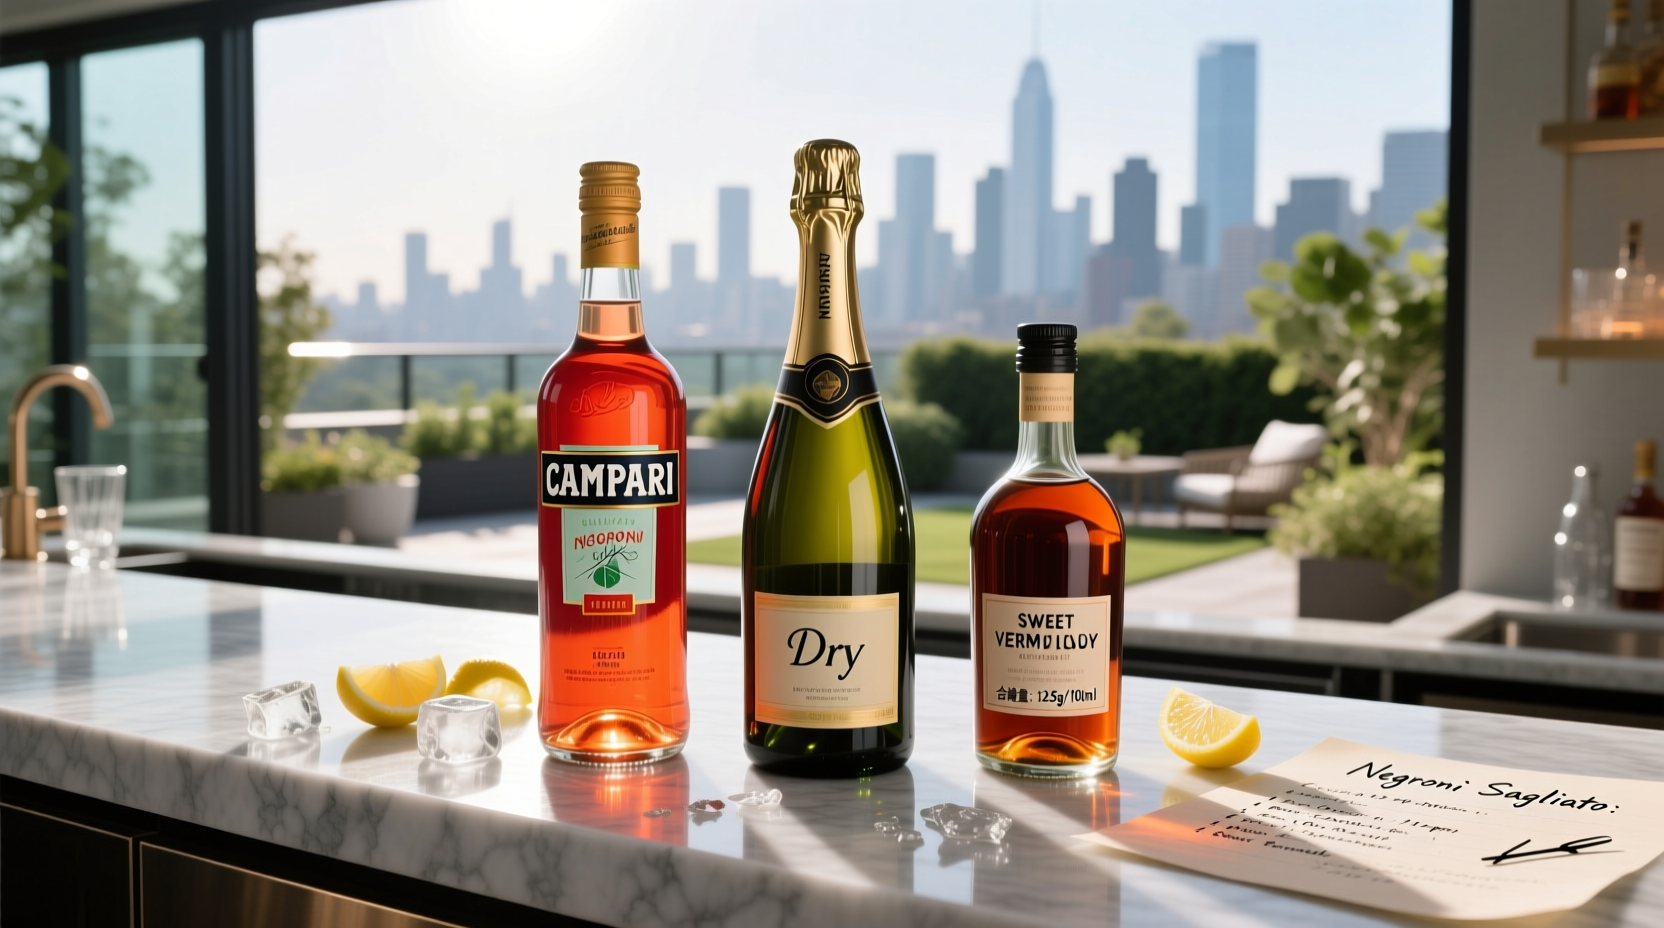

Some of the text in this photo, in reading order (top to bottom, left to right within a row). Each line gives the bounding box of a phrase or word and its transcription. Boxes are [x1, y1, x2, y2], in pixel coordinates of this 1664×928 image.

[546, 462, 674, 497] CAMPARI
[1018, 612, 1075, 629] SWEET
[787, 627, 865, 681] Dry
[1346, 762, 1470, 792] Negroni
[1478, 782, 1620, 813] Sagliato:
